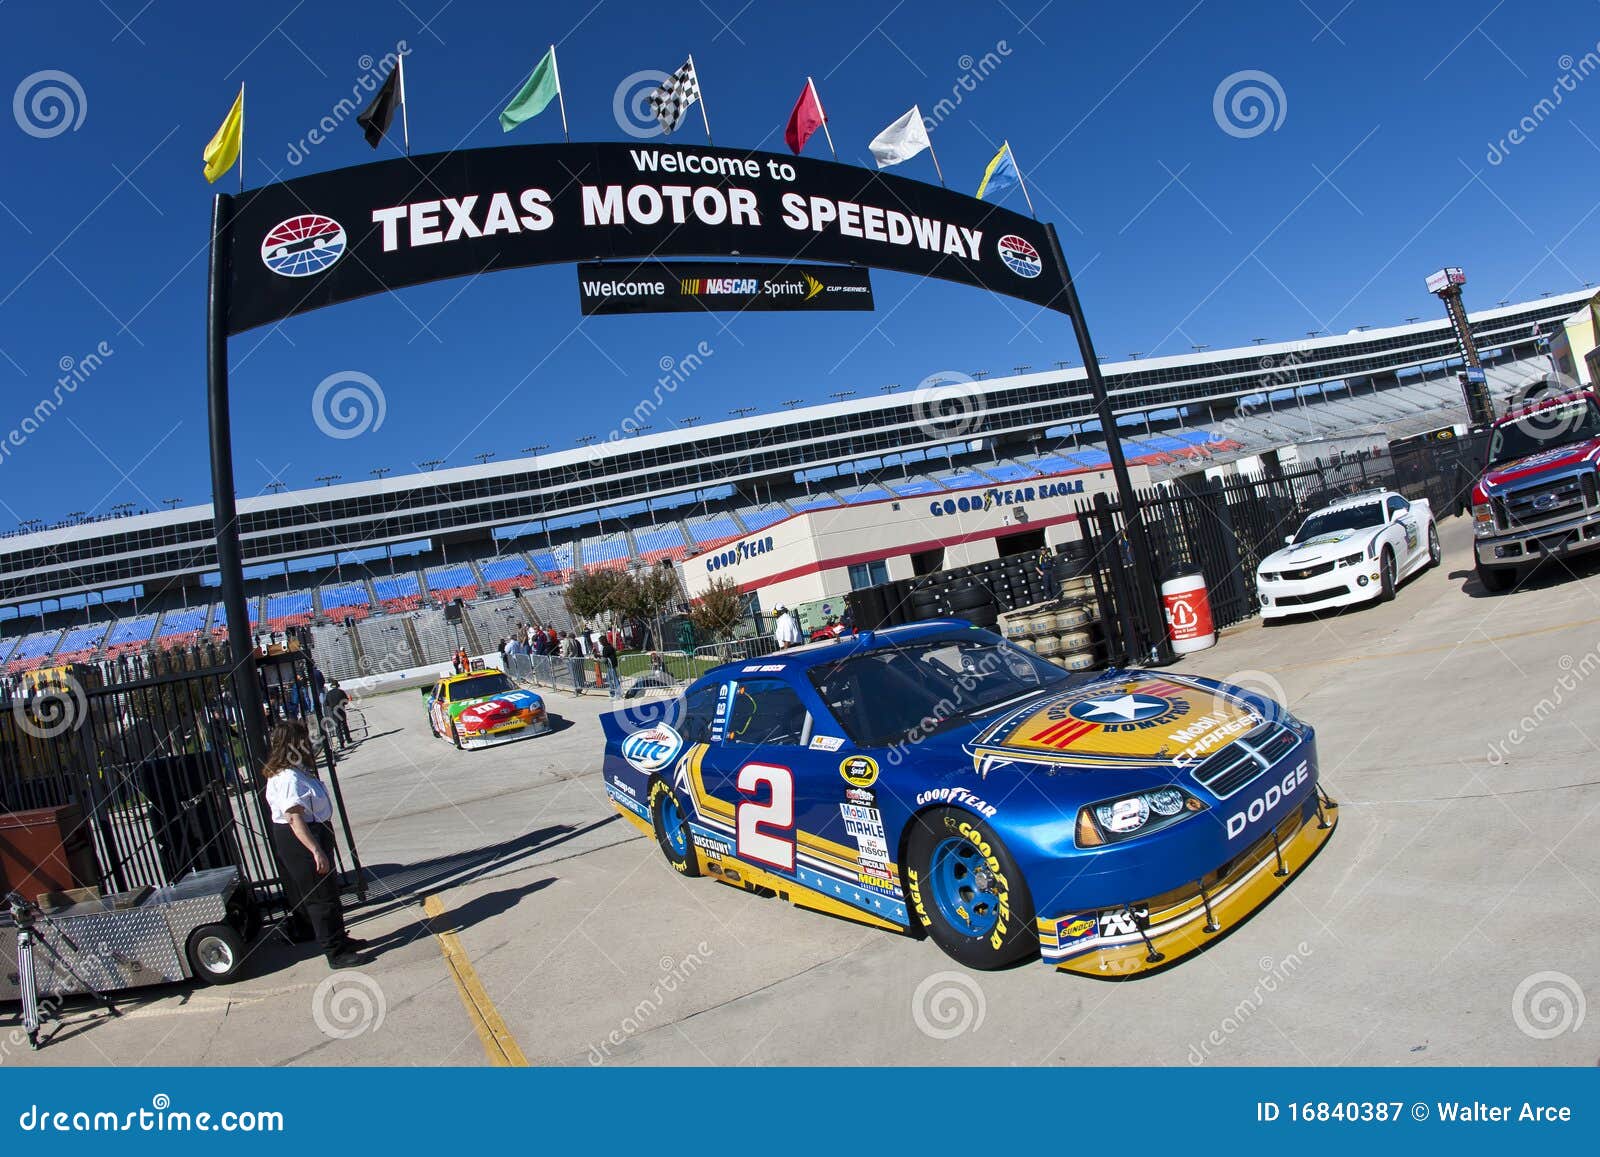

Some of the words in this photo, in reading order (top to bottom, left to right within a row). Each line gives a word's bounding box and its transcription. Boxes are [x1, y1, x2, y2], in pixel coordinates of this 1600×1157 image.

[630, 150, 760, 178] Welcome
[767, 158, 796, 181] to
[372, 188, 554, 252] TEXAS
[581, 184, 762, 226] MOTOR
[781, 192, 983, 261] SPEEDWAY
[583, 280, 665, 297] Welcome
[705, 278, 758, 295] NASCAR
[764, 280, 805, 298] Sprint
[930, 487, 1035, 516] GOODYEAR
[1038, 479, 1085, 499] EAGLE
[706, 536, 774, 572] GOODYEAR
[1168, 716, 1221, 744] Mobil
[1172, 712, 1266, 769] CHARGER
[842, 805, 868, 819] Mobil
[869, 809, 879, 821] 1
[916, 787, 998, 818] GOODYEAR
[1111, 798, 1141, 831] 2
[1226, 759, 1309, 840] DODGE
[736, 762, 796, 872] 2
[845, 819, 885, 838] MAHLE
[693, 834, 729, 855] DISCOUNT
[706, 849, 722, 860] TIRE
[859, 845, 888, 857] TISSOT
[859, 873, 894, 890] MOOG
[908, 867, 932, 927] EAGLE
[958, 822, 1010, 950] GOODYEAR
[1060, 919, 1096, 938] SUNOCO
